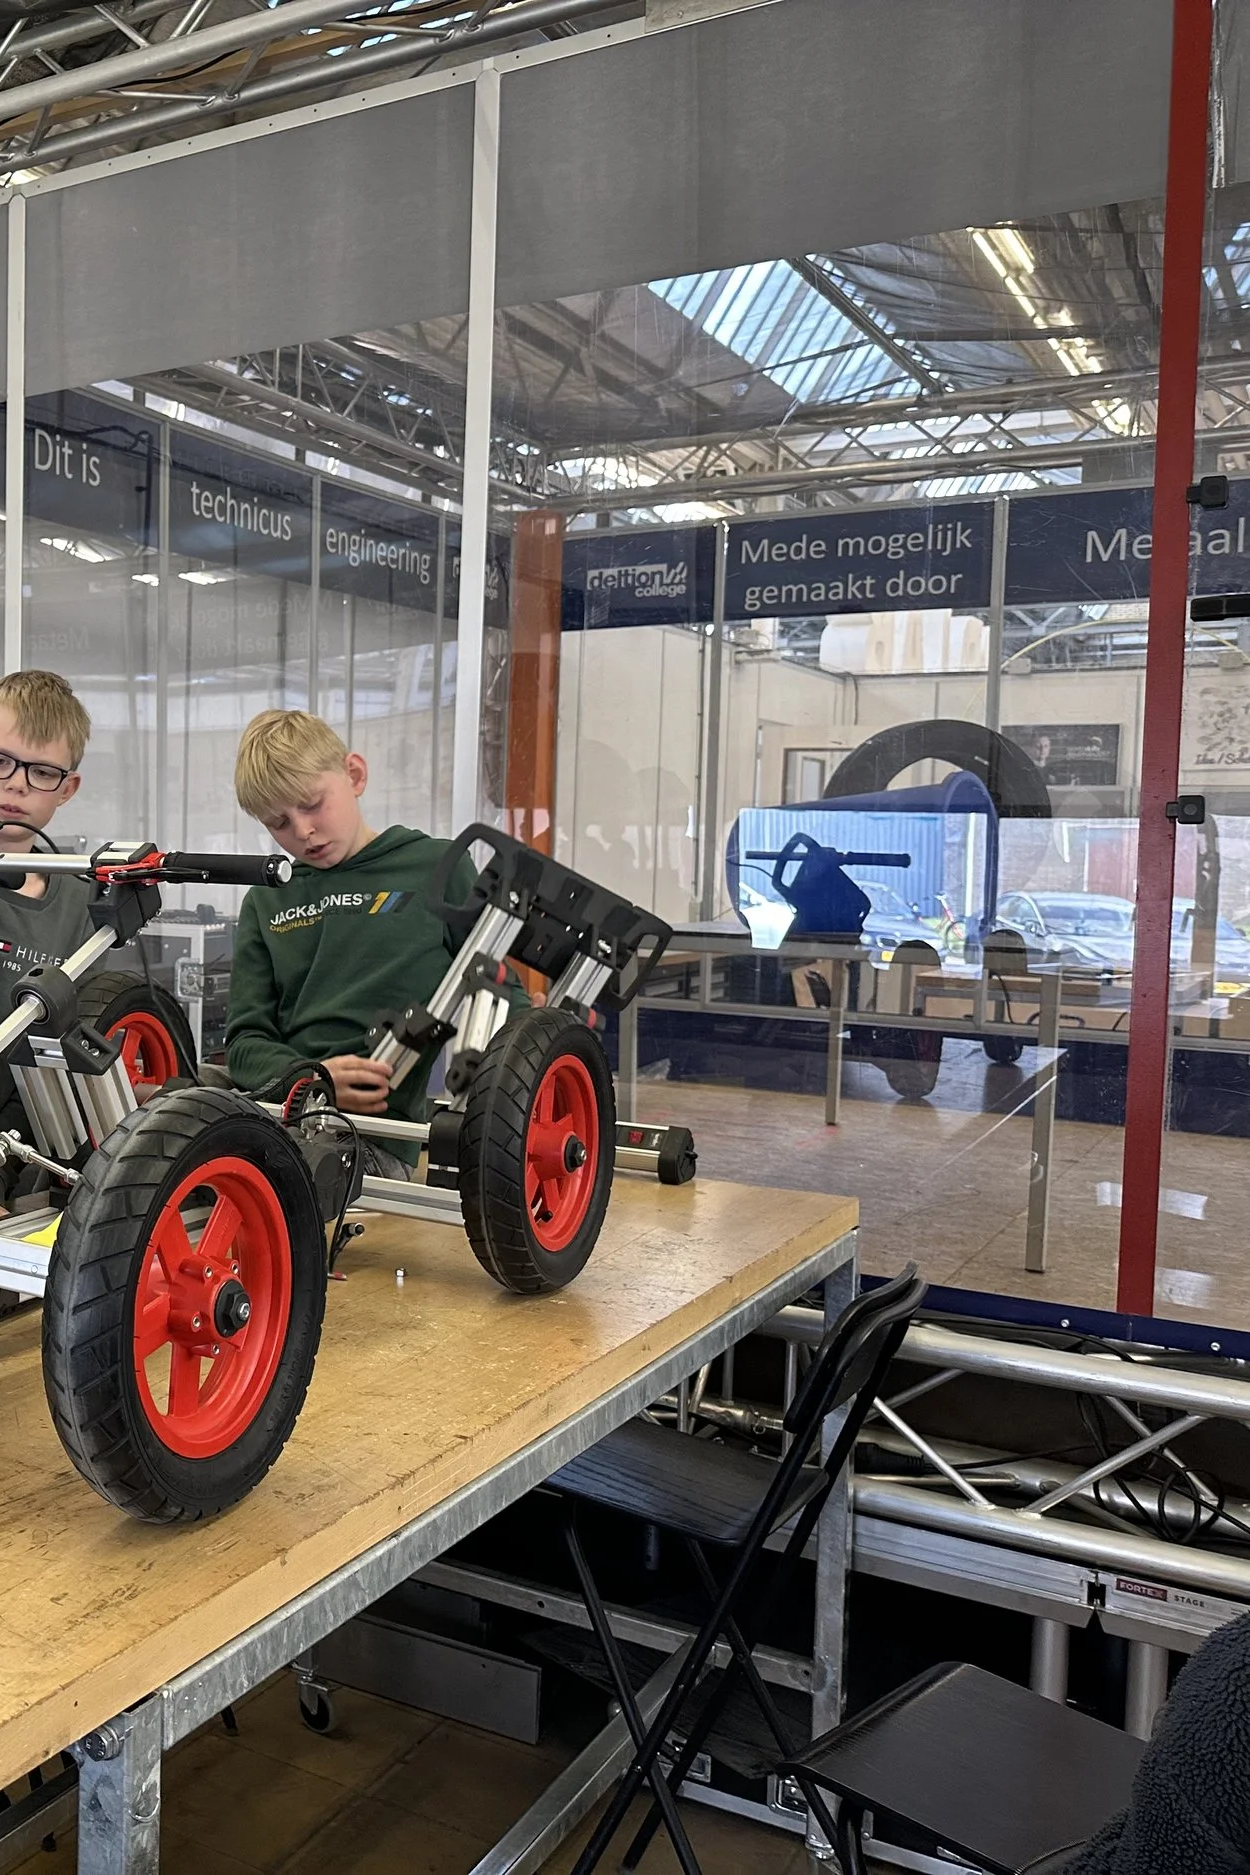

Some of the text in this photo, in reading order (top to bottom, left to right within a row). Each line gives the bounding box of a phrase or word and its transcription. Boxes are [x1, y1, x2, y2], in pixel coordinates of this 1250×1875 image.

[34, 428, 101, 487] Dit is
[189, 480, 292, 541] technicus
[325, 526, 431, 585] engineering
[740, 521, 973, 564] Mede mogelijk
[1085, 517, 1246, 563] Meaal
[588, 567, 665, 590] deltion
[634, 583, 687, 598] college
[743, 569, 963, 611] gemaakt door
[2, 960, 22, 972] 1985
[1173, 1594, 1206, 1608] STAGE
